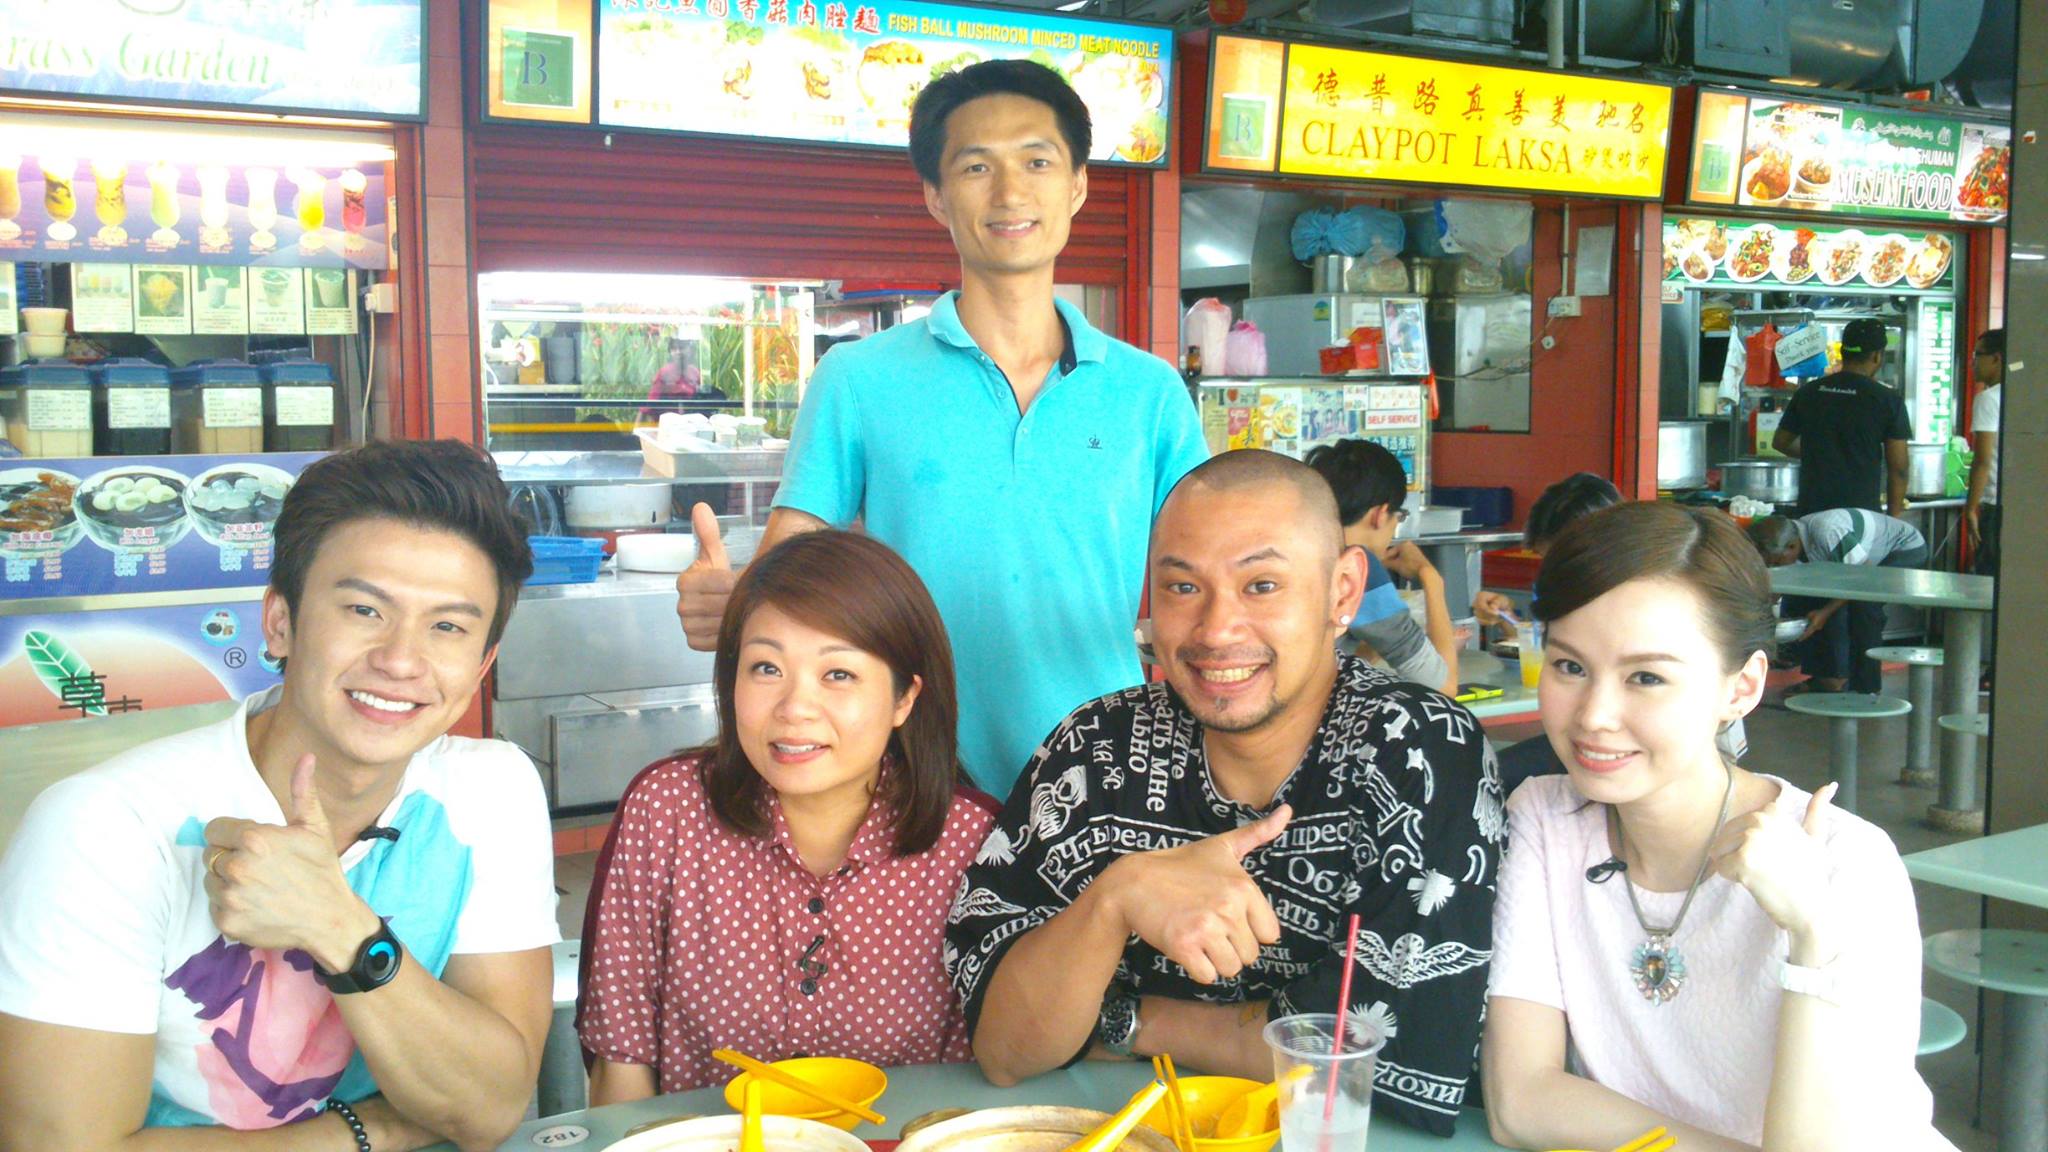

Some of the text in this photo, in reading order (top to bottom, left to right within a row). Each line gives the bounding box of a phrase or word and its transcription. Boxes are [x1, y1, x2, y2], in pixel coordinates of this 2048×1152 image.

[888, 13, 1160, 58] FISH BALL MUSHROOM MINCED MEAT NOODLE
[118, 31, 271, 84] Garden
[522, 51, 548, 85] B
[1302, 120, 1572, 174] CLAYPOT LAKSA
[1902, 171, 1954, 211] FOOD
[1367, 414, 1418, 424] SELF SERVICE
